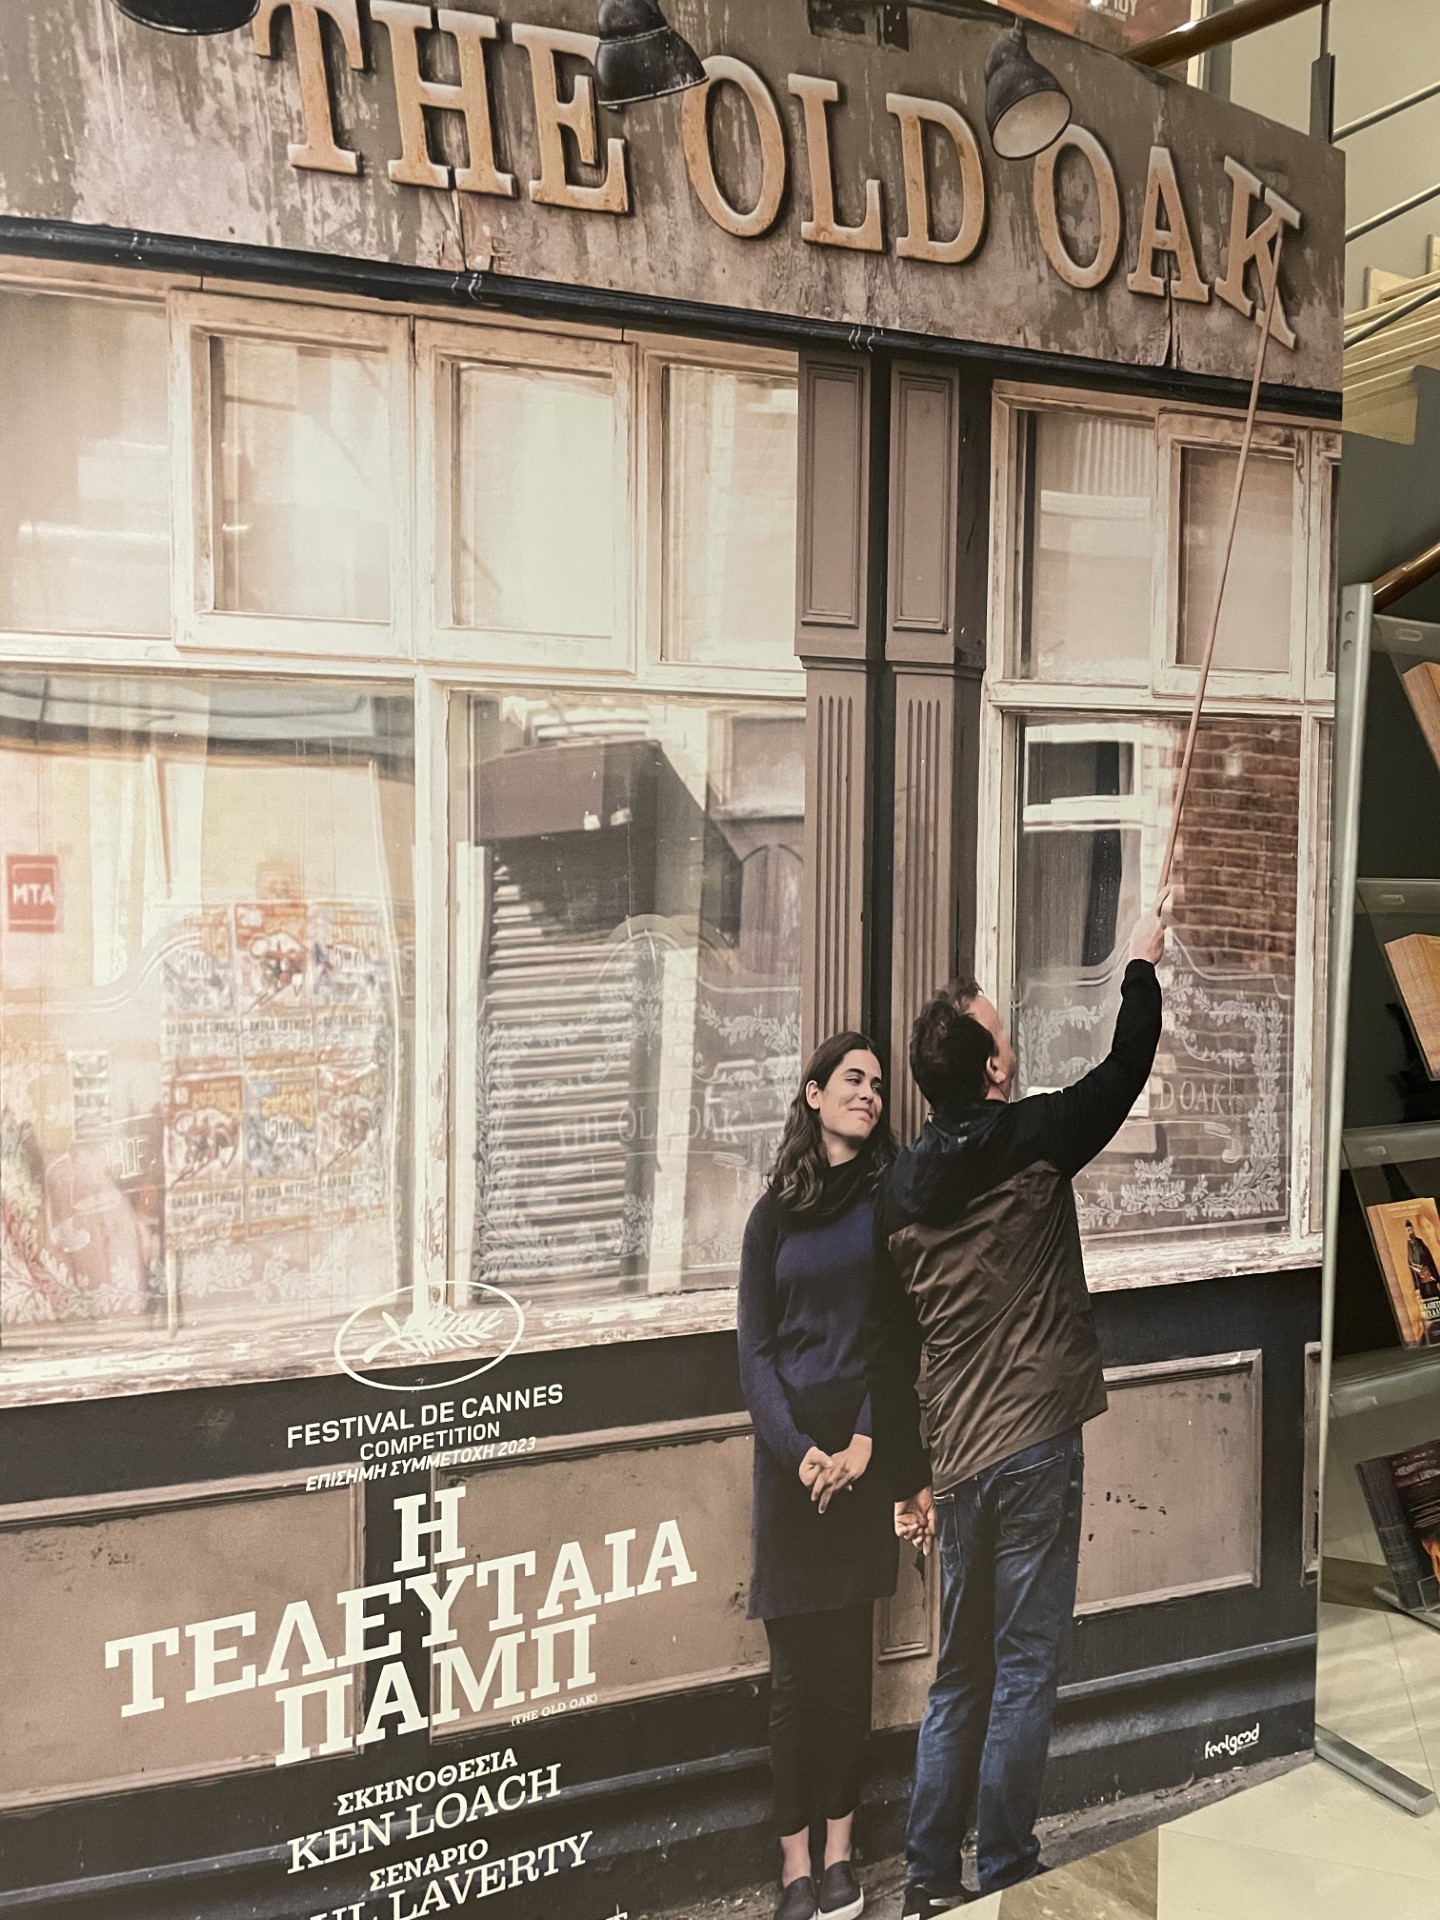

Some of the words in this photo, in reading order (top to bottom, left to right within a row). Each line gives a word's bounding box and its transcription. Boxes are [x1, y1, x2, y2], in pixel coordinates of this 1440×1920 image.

[252, 0, 630, 214] THE
[681, 53, 987, 265] OLD
[1031, 122, 1301, 351] OAK
[286, 1408, 415, 1449] FESTIVAL
[421, 1401, 455, 1426] DE
[461, 1383, 564, 1420] CANNES
[359, 1421, 500, 1461] COMPETITION
[305, 1462, 388, 1492] ΕΠΙΣΗΜΗ
[390, 1442, 495, 1477] ΣΥΜΜΕΤΟΧΗ
[498, 1436, 536, 1457] 2023
[393, 1486, 467, 1573] Η
[104, 1519, 697, 1718] ΤΕΛΕΥΤΑΙΑ
[274, 1613, 597, 1767] ΠΑΜΠ
[511, 1711, 539, 1727] (THE
[541, 1702, 567, 1718] OLD
[569, 1693, 598, 1709] OAK)
[1204, 1722, 1260, 1759] feelgood
[337, 1748, 518, 1816] ΣΚΗΝΟΘΕΣΙΑ
[287, 1811, 396, 1874] KEN
[405, 1763, 562, 1841] LOACH
[369, 1838, 489, 1892] ΣΕΝΑΡΙΟ
[388, 1830, 594, 1920] LAVERTY
